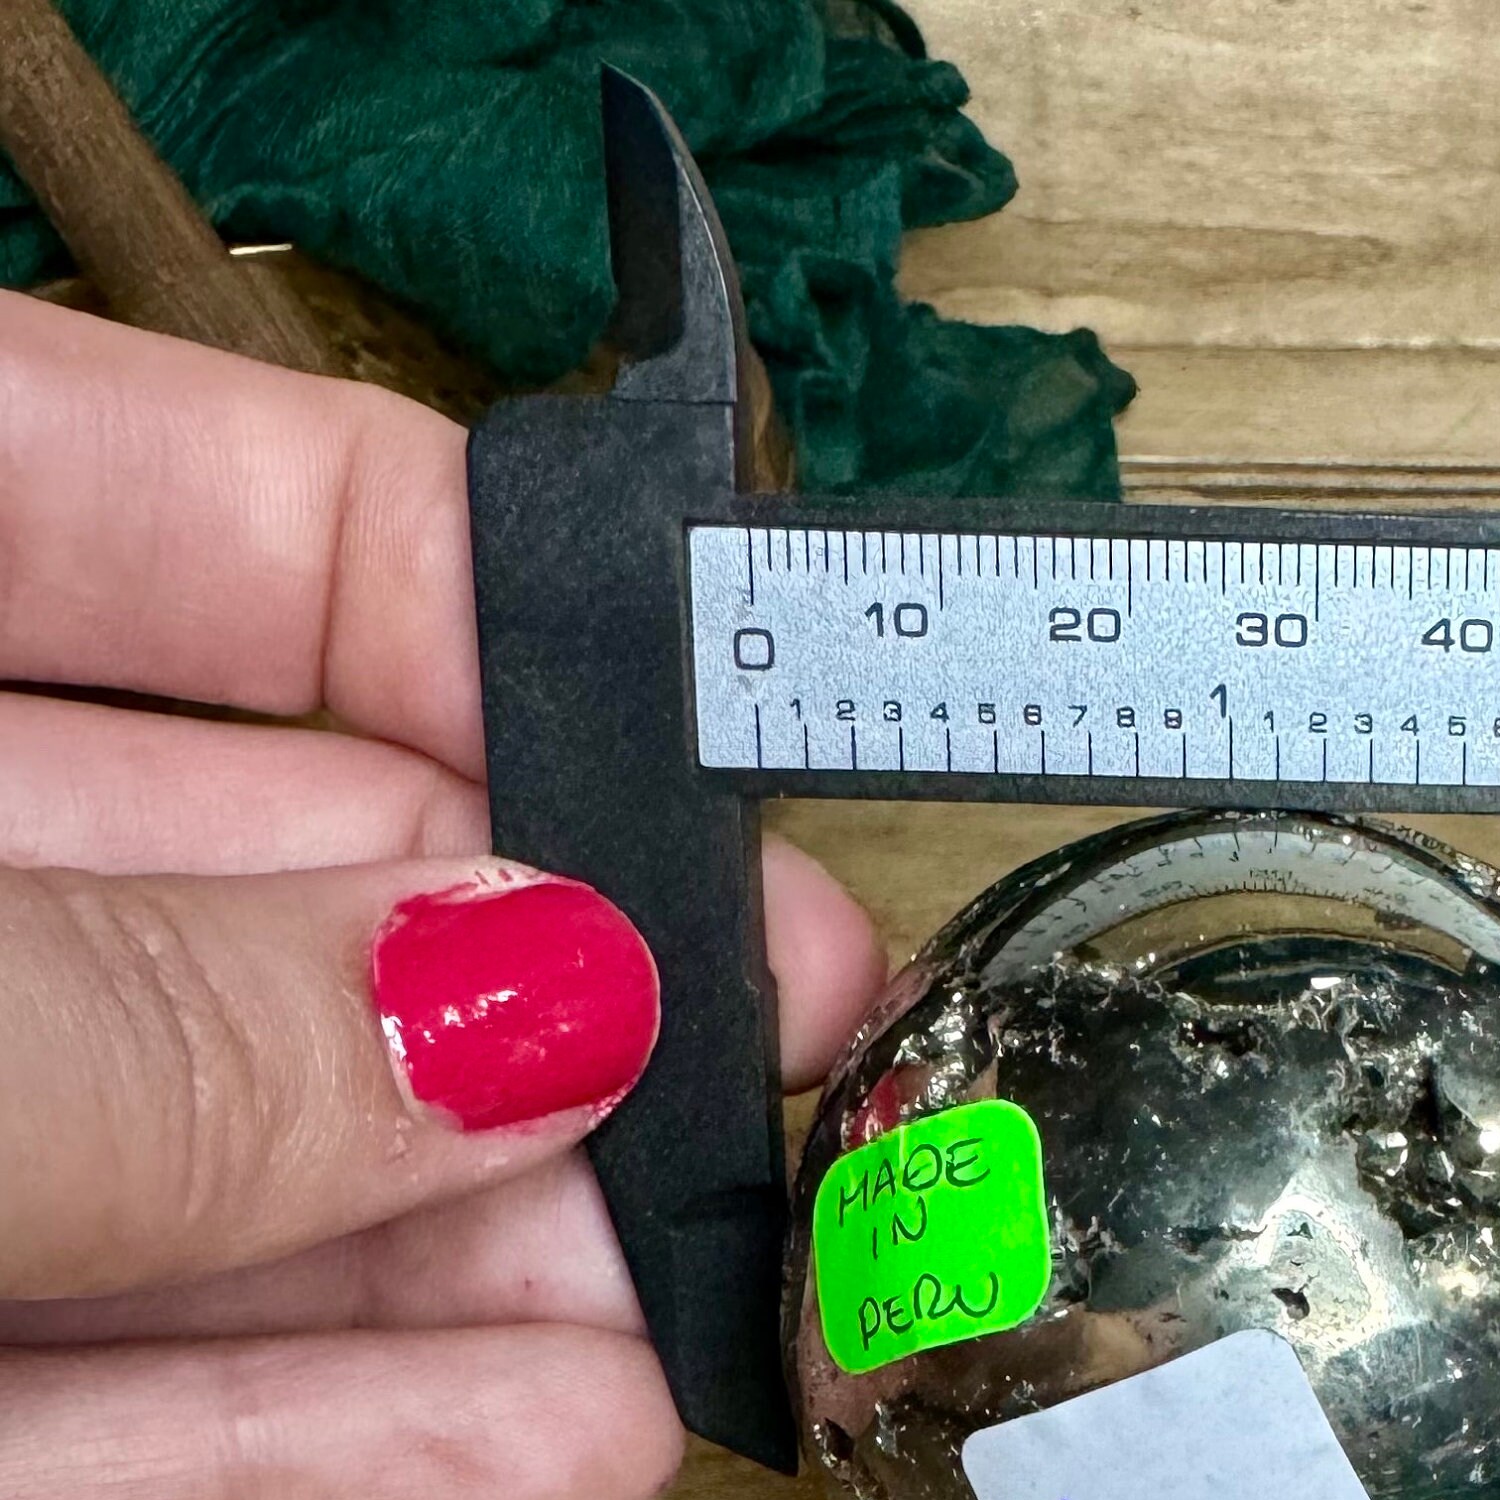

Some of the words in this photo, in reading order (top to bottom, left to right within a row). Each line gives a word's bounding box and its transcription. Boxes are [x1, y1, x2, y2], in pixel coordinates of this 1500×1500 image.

[733, 627, 776, 672] 0
[864, 601, 928, 638] 10
[1048, 606, 1121, 643] 20
[1236, 612, 1308, 648] 30
[1421, 618, 1493, 653] 40
[790, 698, 802, 720] 1
[835, 699, 856, 721] 2
[883, 700, 903, 722] 3
[929, 701, 950, 723] 4
[1023, 703, 1043, 726] 6
[1068, 705, 1088, 727] 7
[1116, 706, 1136, 728] 8
[1210, 683, 1227, 718] 1
[1264, 710, 1275, 733] 1
[1308, 711, 1328, 733] 2
[1354, 713, 1373, 734] 3
[1400, 714, 1419, 735] 4
[1448, 715, 1466, 736] 5
[871, 1195, 928, 1260] IN
[857, 1270, 999, 1351] PERU
